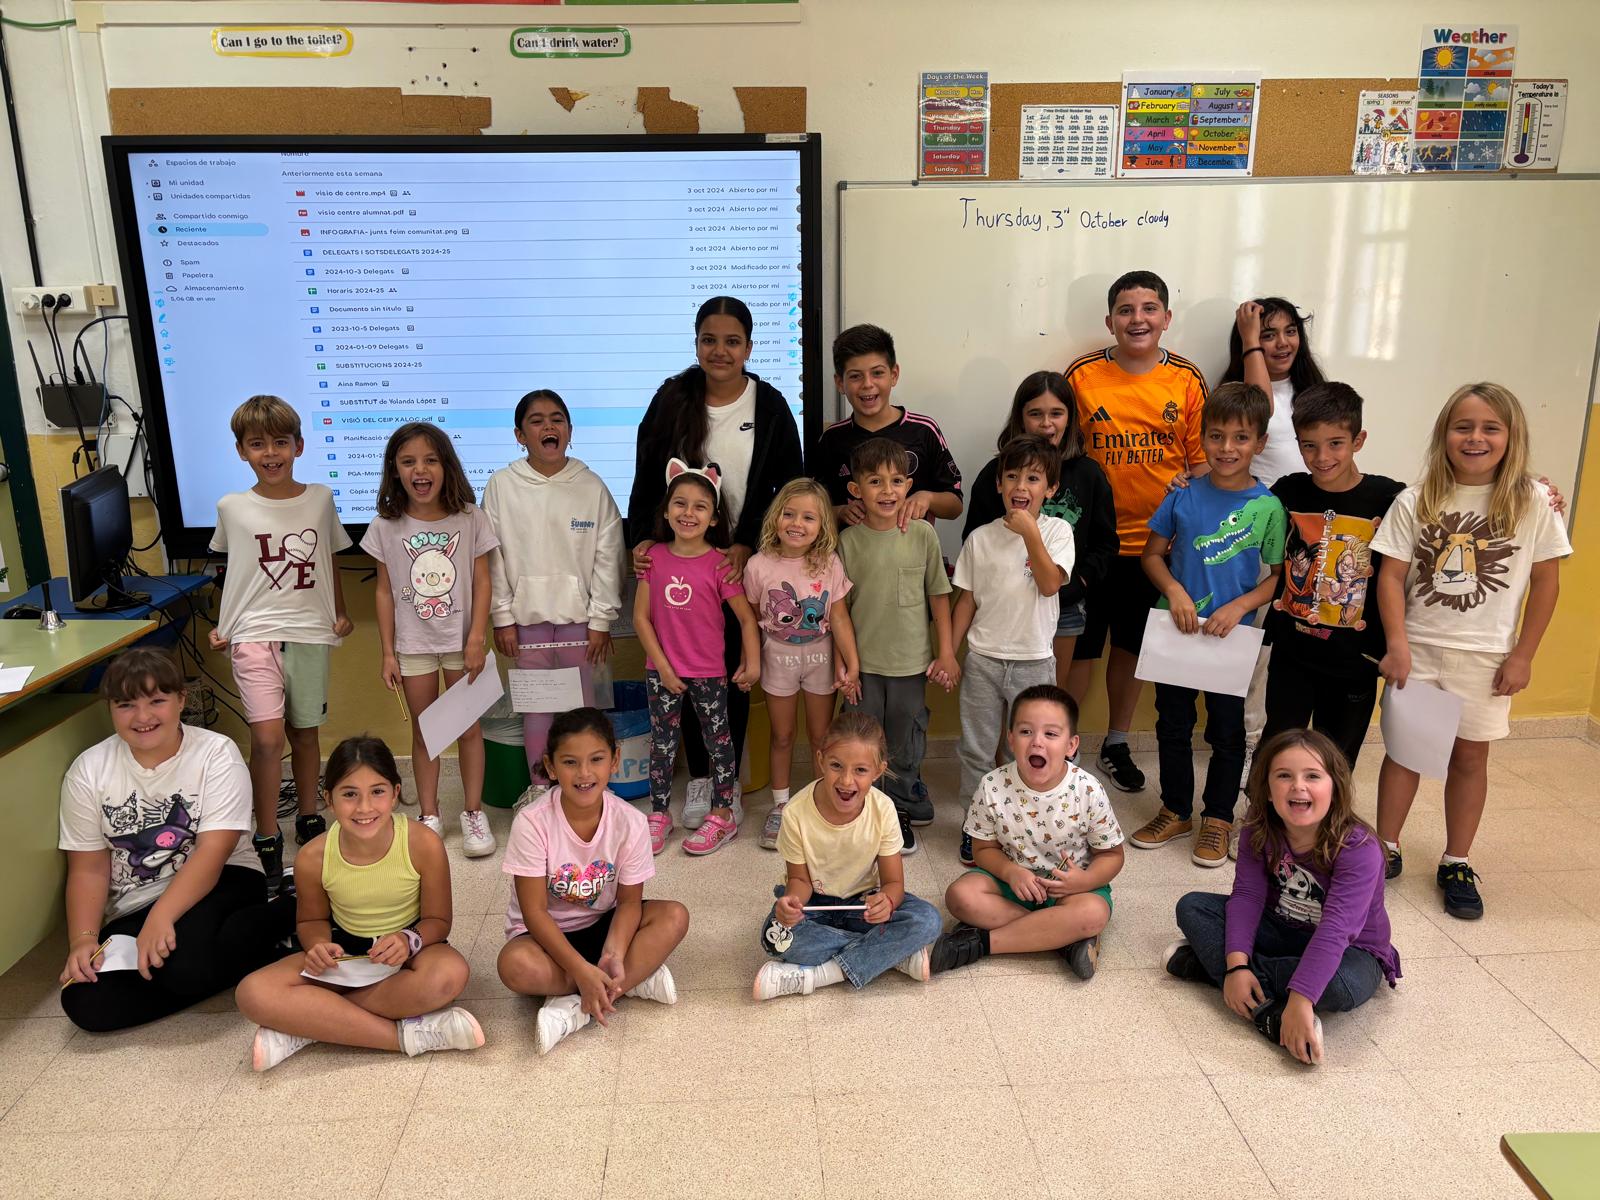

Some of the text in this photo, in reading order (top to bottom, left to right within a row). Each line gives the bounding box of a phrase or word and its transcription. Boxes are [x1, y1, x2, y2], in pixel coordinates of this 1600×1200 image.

[221, 34, 342, 48] Can I go to the toilet?
[1434, 28, 1507, 44] Weather
[518, 37, 618, 48] Can I drink water?
[1144, 88, 1175, 97] January
[1214, 88, 1230, 97] July
[1141, 102, 1176, 111] February
[1208, 102, 1234, 111] August
[1200, 116, 1240, 125] September
[1147, 130, 1165, 138] April
[1148, 144, 1163, 152] May
[1080, 210, 1127, 229] October
[1137, 210, 1169, 227] cloudy
[1093, 430, 1175, 449] Emirates
[1106, 448, 1164, 465] FLY BETTER
[410, 532, 449, 549] LOVE
